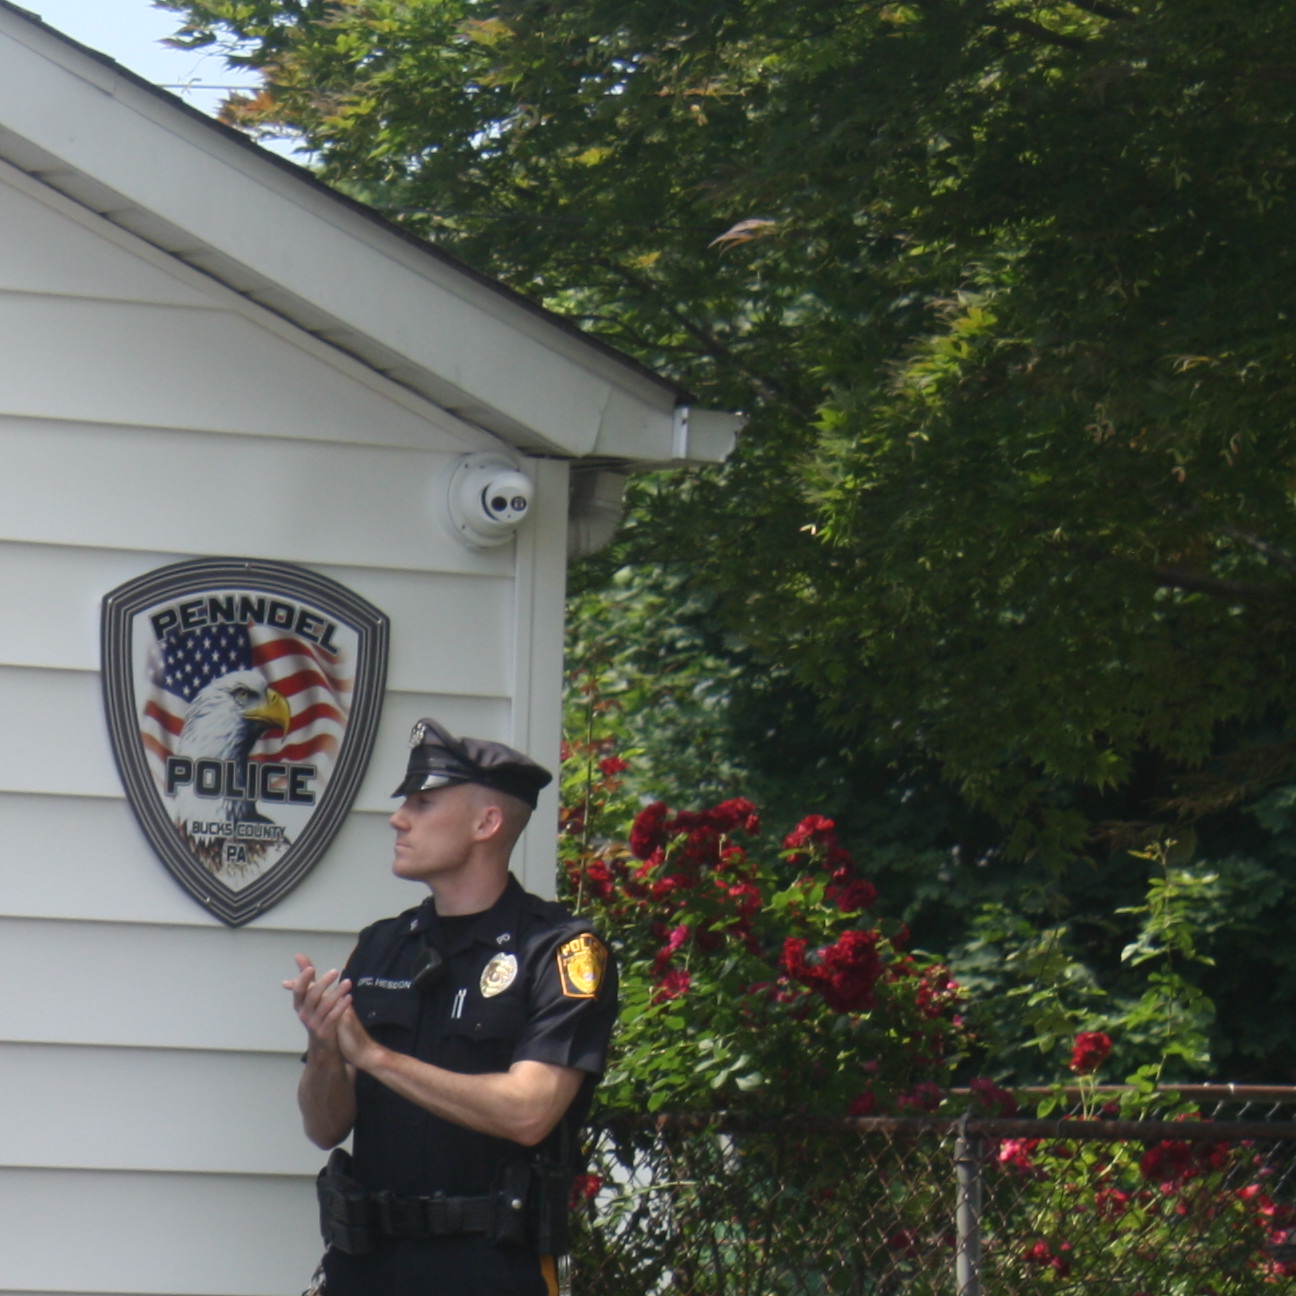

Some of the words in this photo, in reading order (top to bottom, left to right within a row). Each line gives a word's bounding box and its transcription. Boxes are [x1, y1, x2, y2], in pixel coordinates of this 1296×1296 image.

[150, 595, 339, 656] PENNDEL
[165, 756, 317, 806] POLICE
[191, 820, 233, 836] BUCKS
[236, 823, 286, 840] COUNTY
[226, 845, 246, 863] PA
